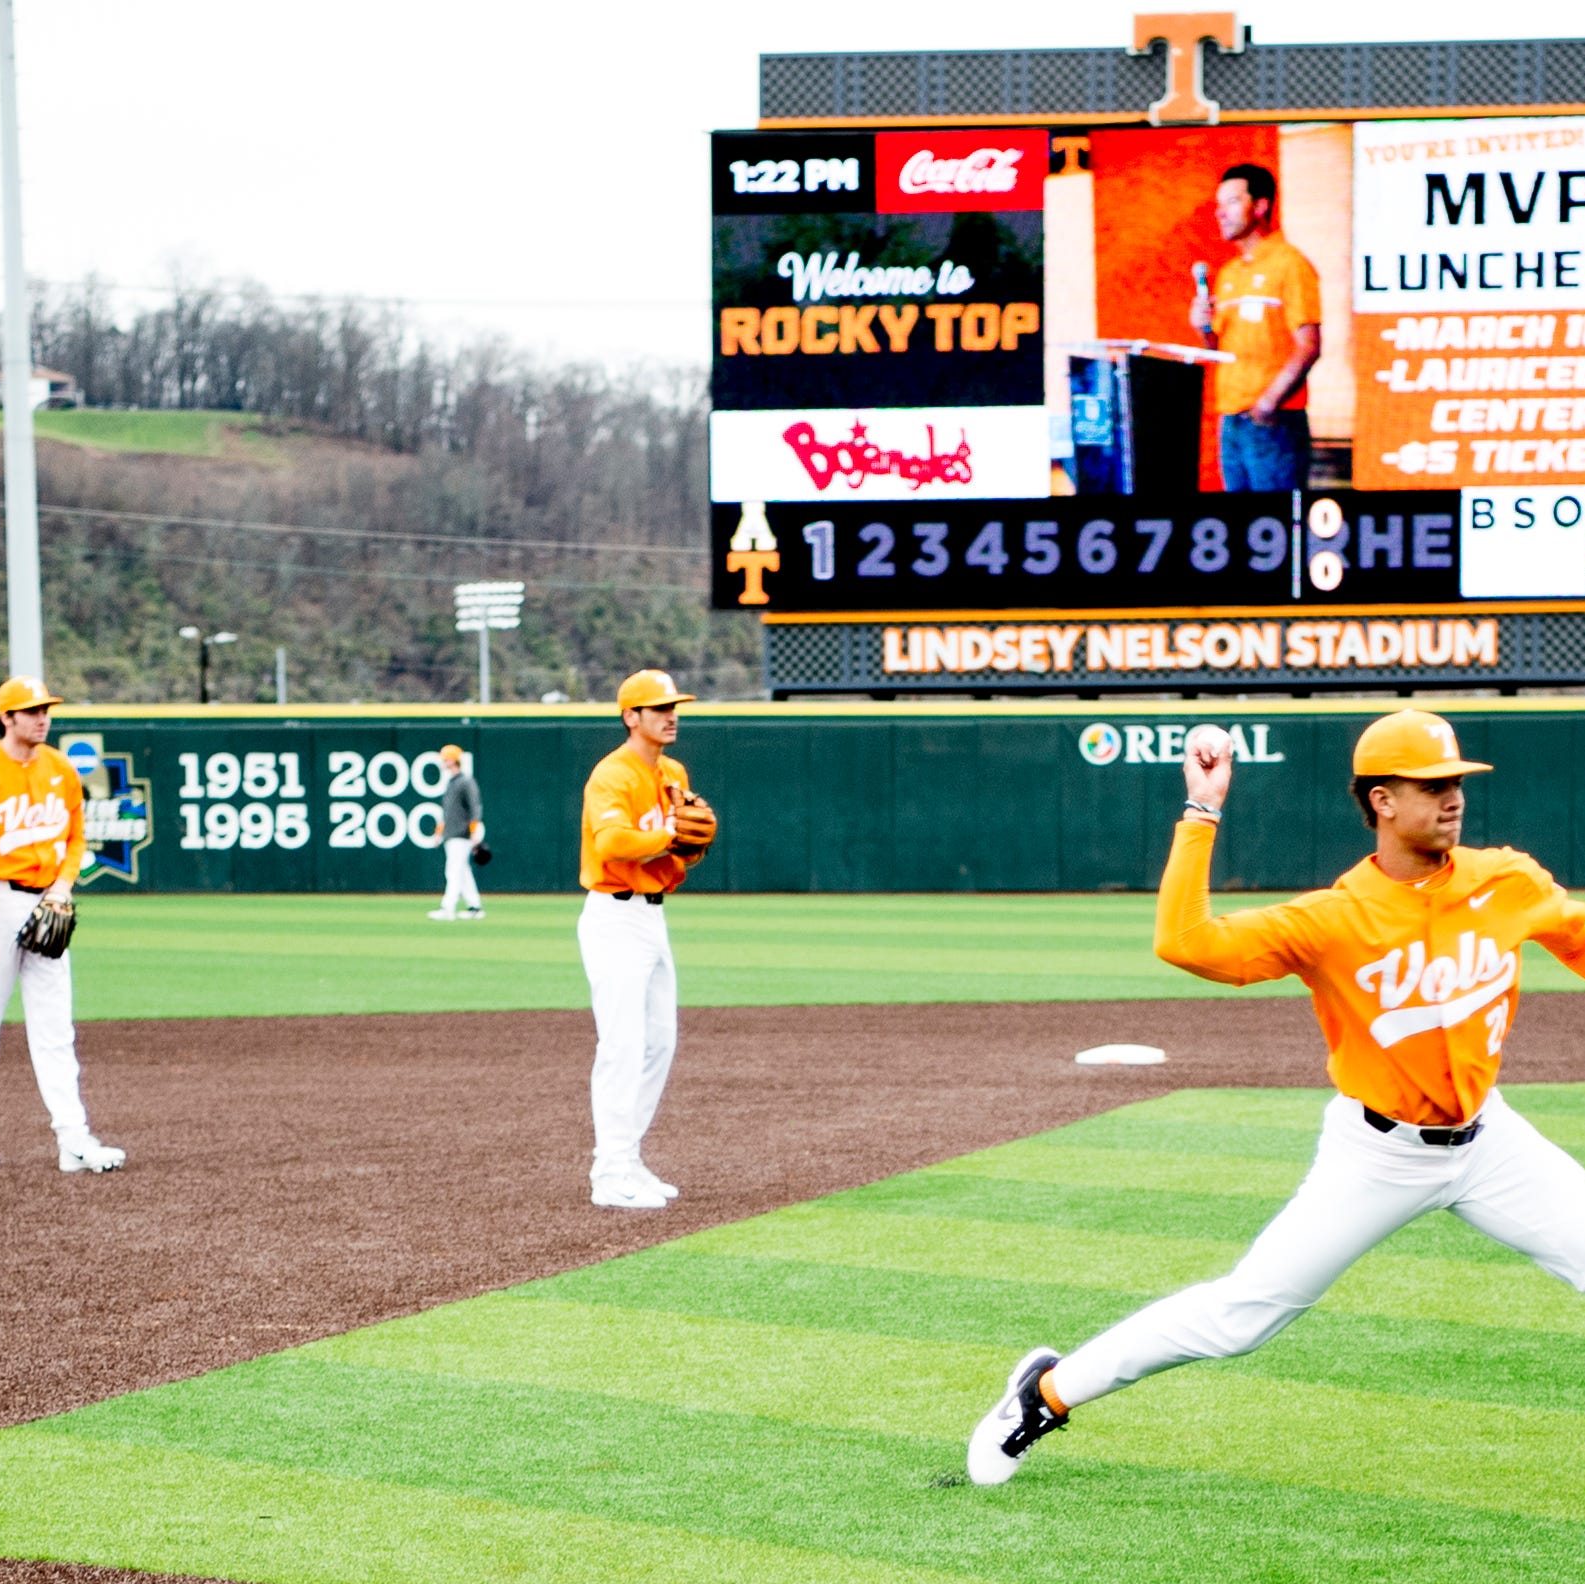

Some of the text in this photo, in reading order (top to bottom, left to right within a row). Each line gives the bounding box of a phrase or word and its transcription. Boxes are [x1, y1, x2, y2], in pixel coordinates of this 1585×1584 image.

[1128, 12, 1244, 126] T
[1365, 139, 1457, 165] YOU'RE
[1466, 128, 1584, 156] INVITED!
[729, 157, 859, 193] 1:22 PM
[777, 251, 975, 301] Welcome to
[720, 302, 1040, 356] ROCKY TOP
[1472, 499, 1494, 529] B
[1515, 498, 1535, 528] S
[802, 520, 835, 580] 1
[857, 522, 896, 577] 2
[911, 522, 950, 577] 3
[965, 521, 1009, 575] 4
[1022, 520, 1061, 575] 5
[1077, 519, 1117, 574] 6
[1135, 519, 1173, 573] 7
[1190, 518, 1230, 572] 8
[1247, 516, 1288, 571] 9
[726, 551, 780, 605] T
[883, 618, 1500, 672] LINDSEY NELSON STADIUM
[1122, 723, 1285, 764] REAL
[178, 752, 306, 799] 1951
[179, 802, 444, 850] 1995 200
[1355, 930, 1516, 1049] Vols
